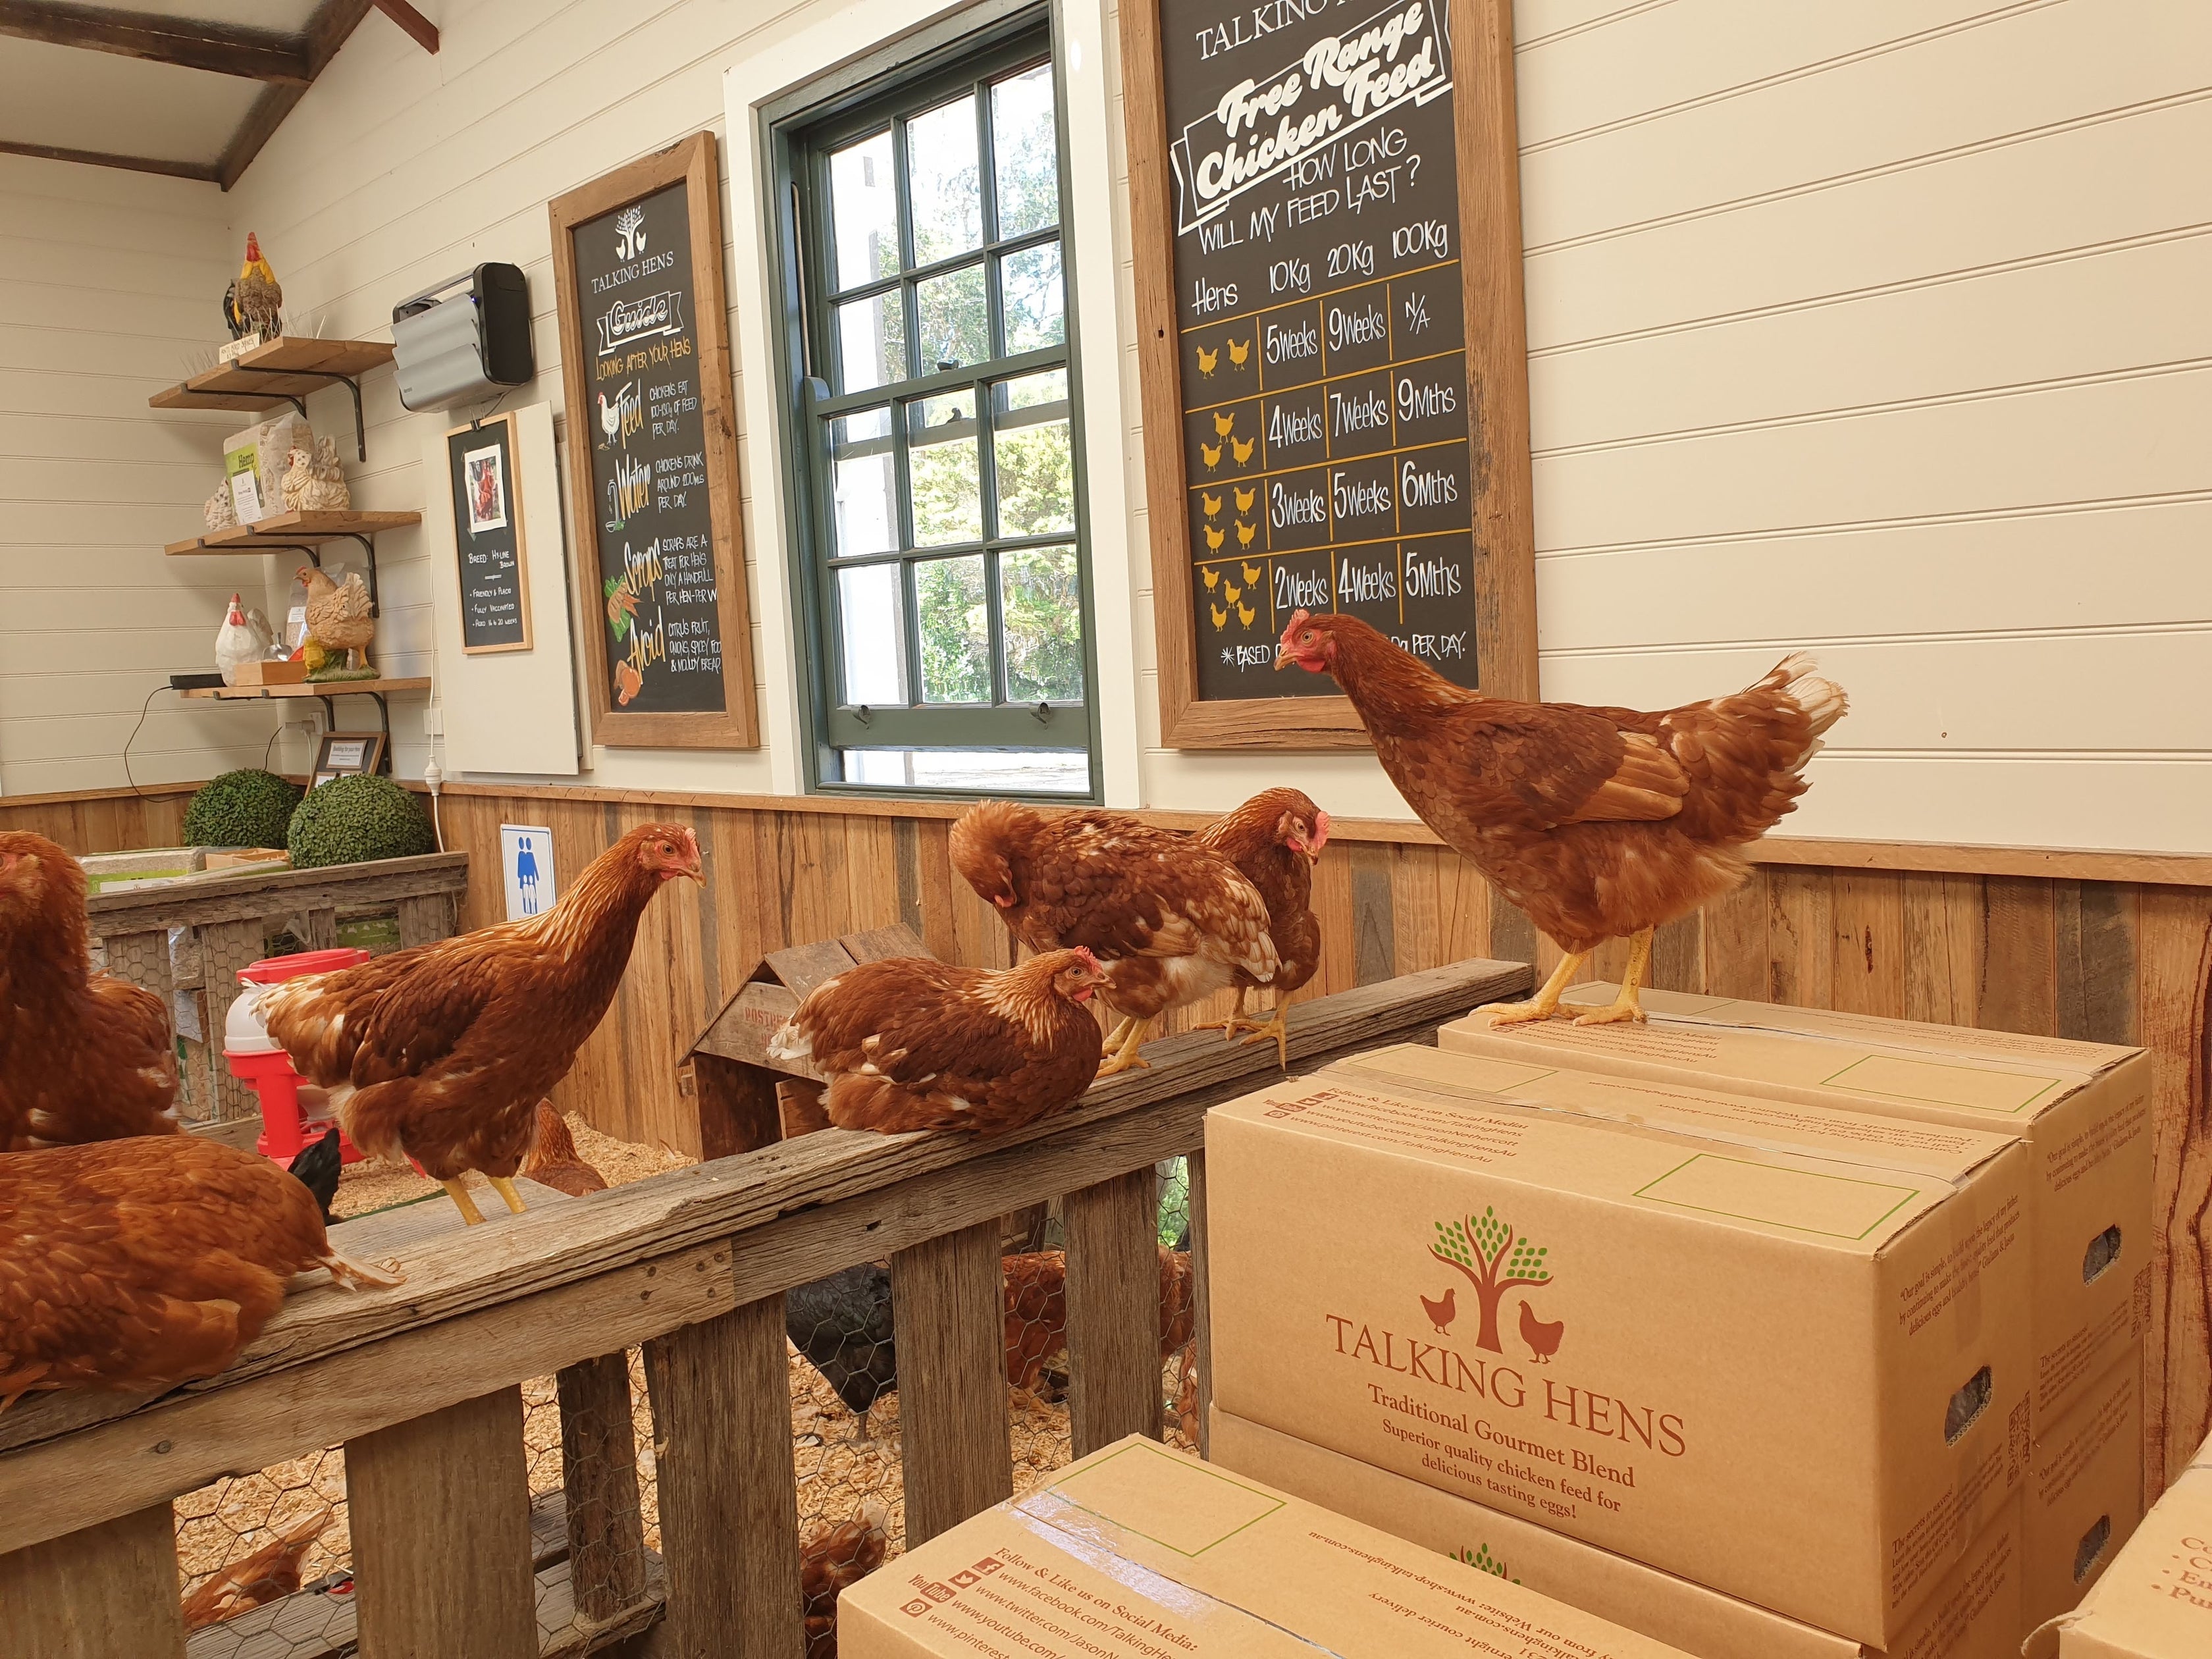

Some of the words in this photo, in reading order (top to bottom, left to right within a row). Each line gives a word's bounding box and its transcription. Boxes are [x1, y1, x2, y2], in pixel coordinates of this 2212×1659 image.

[1217, 73, 1303, 138] Free
[1304, 2, 1424, 90] Range
[1196, 104, 1343, 199] Chicken
[1343, 36, 1436, 117] Feed
[1282, 143, 1336, 191] HOW
[1344, 126, 1408, 172] LONG
[1199, 220, 1244, 255] WILL
[1250, 203, 1279, 242] MY
[1288, 189, 1339, 227] FEED
[1346, 165, 1402, 214] LAST
[591, 264, 640, 294] TALKING
[642, 251, 674, 276] HENS
[1269, 257, 1311, 294] 10Kg
[1327, 240, 1374, 277] 20Kg
[1192, 277, 1238, 315] Hens
[1405, 292, 1431, 334] N/A
[610, 296, 668, 336] Guide
[596, 355, 623, 381] LOOKING
[626, 351, 649, 377] AFTER
[648, 339, 672, 370] YOUR
[670, 336, 691, 359] HENS
[649, 382, 676, 401] CHICKENS
[678, 380, 689, 395] EAT
[673, 399, 681, 415] OF
[682, 397, 697, 413] FEED
[616, 378, 644, 450] Feed
[652, 423, 666, 440] PER
[238, 453, 254, 468] Hemp
[656, 456, 683, 473] CHICKENS
[684, 451, 704, 469] DRINK
[616, 454, 651, 521] Water
[657, 475, 681, 494] AROUND
[658, 496, 672, 514] PER
[468, 553, 488, 564] BREED:
[662, 537, 685, 552] SCRAPS
[686, 535, 698, 550] ARE
[701, 533, 708, 548] A
[624, 537, 663, 602] Scraps
[662, 556, 677, 571] TREAT
[679, 555, 690, 571] FOR
[691, 552, 707, 567] HENS
[664, 571, 677, 589] ONLY
[678, 571, 683, 586] A
[683, 567, 714, 585] HANDFULL
[473, 589, 492, 598] FRIENDLY
[475, 604, 487, 614] FULLY
[490, 603, 515, 612] VACCINATED
[666, 591, 679, 606] PER
[627, 605, 666, 685] Avoid
[668, 618, 689, 637] CITRUS
[1412, 634, 1441, 660] PER
[1440, 631, 1466, 659] DAY.
[678, 656, 700, 673] MOULDY
[711, 639, 722, 654] FOO
[1327, 1088, 1365, 1099] Follow
[1382, 1099, 1409, 1109] Like
[1445, 1112, 1485, 1122] Social
[1338, 1098, 1524, 1137] www.facebook.com/TalkingHens
[1326, 1313, 1526, 1408] TALKING
[1542, 1379, 1685, 1457] HENS
[1367, 1382, 1469, 1434] Traditional
[1474, 1419, 1566, 1466] Gourmet
[1571, 1449, 1636, 1488] Blend
[1382, 1418, 1440, 1454] Superior
[1444, 1442, 1493, 1471] quality
[1497, 1458, 1556, 1490] chicken
[1560, 1478, 1593, 1503] feed
[1596, 1490, 1622, 1514] for
[1421, 1453, 1483, 1487] delicious
[1486, 1477, 1536, 1508] tasting
[1539, 1498, 1577, 1519] eggs!
[1308, 1531, 1476, 1606] www.shop.talkinghens.com.au
[908, 1573, 957, 1604] YouTube
[994, 1547, 1034, 1571] Follow
[1034, 1567, 1049, 1579] &
[1048, 1573, 1077, 1593] Like
[1077, 1590, 1094, 1601] us
[1093, 1598, 1111, 1610] on
[1112, 1605, 1155, 1629] Social
[1150, 1623, 1198, 1651] Media:
[1368, 1593, 1417, 1618] delivery
[951, 1600, 1066, 1659] www.youtube.com/
[976, 1586, 1120, 1659] www.twitter.com/JasonN
[1417, 1615, 1463, 1639] courier
[1456, 1605, 1579, 1659] alkinghens.com.au
[1478, 1603, 1533, 1632] Website:
[1535, 1627, 1561, 1643] our
[927, 1614, 1011, 1659] www.pinteres
[1563, 1639, 1598, 1658] from
